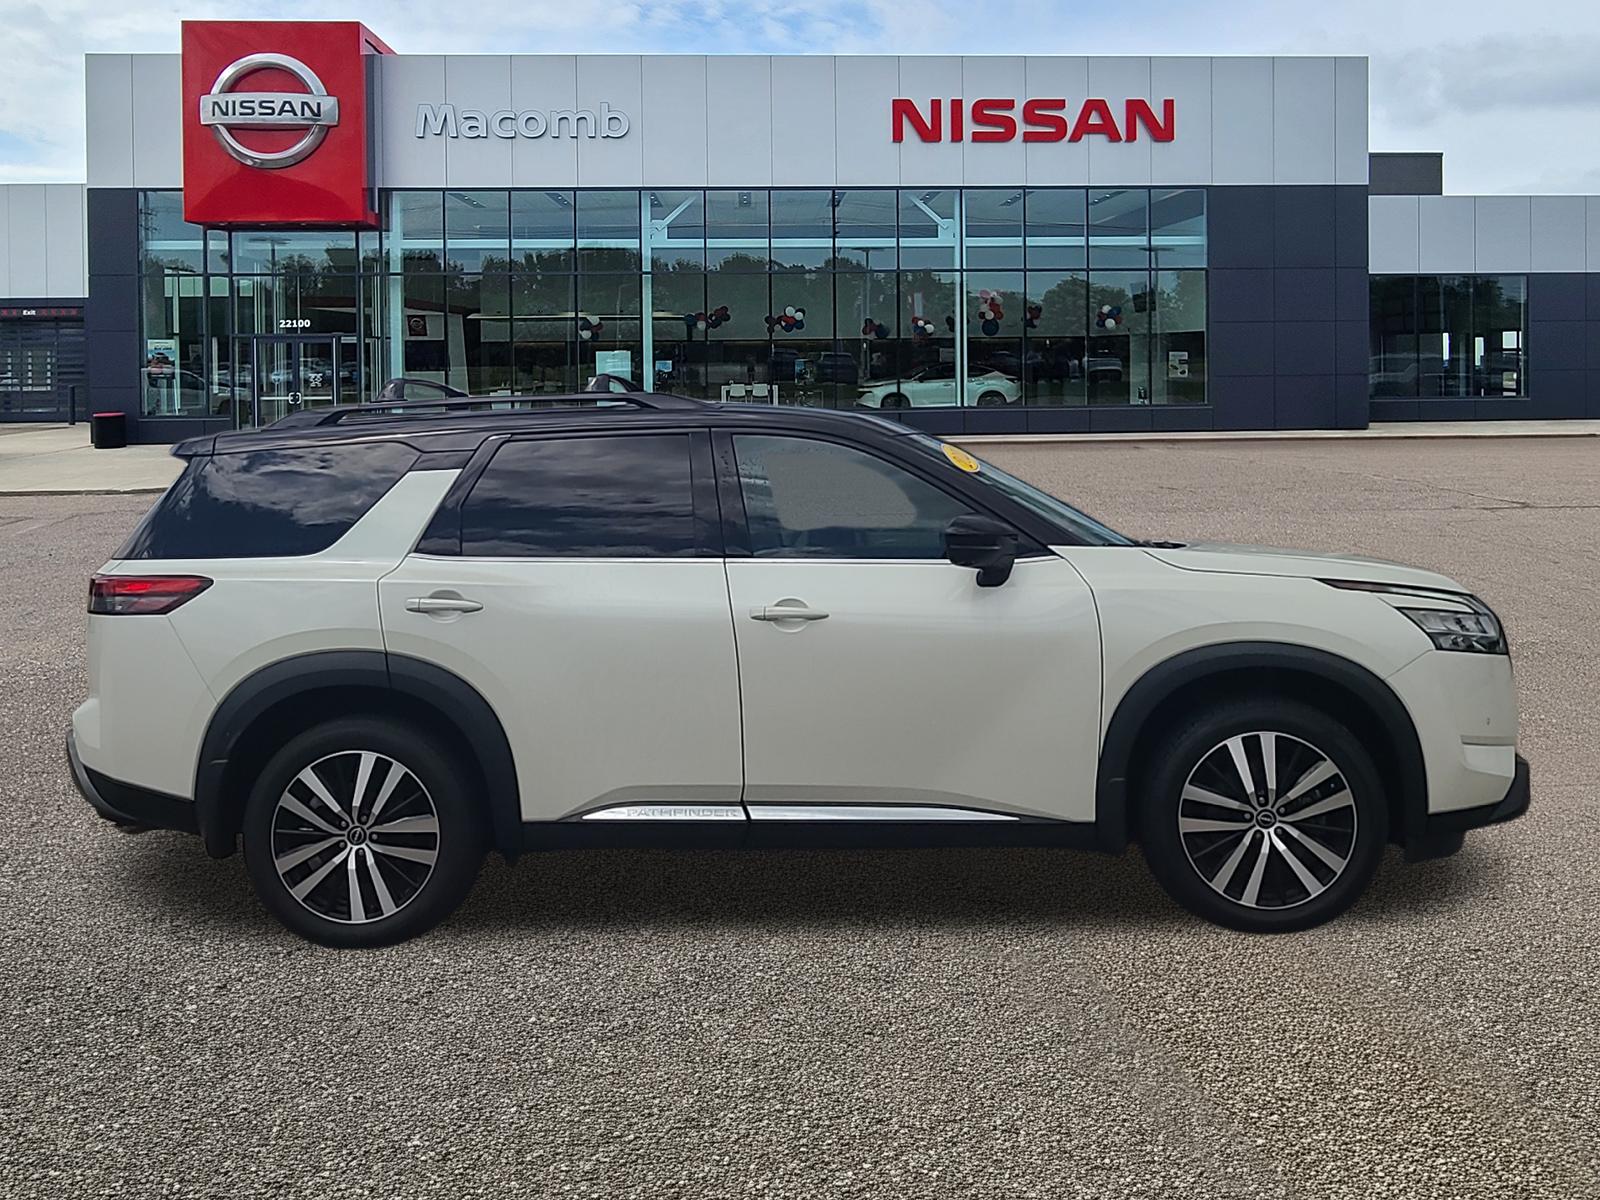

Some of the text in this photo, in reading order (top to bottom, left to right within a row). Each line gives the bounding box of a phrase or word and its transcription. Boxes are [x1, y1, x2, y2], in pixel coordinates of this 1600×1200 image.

[211, 100, 322, 118] NISSAN
[415, 102, 630, 138] Macomb
[892, 98, 1175, 143] NISSAN
[279, 319, 311, 328] 22100
[626, 807, 741, 817] PATHFINDER
